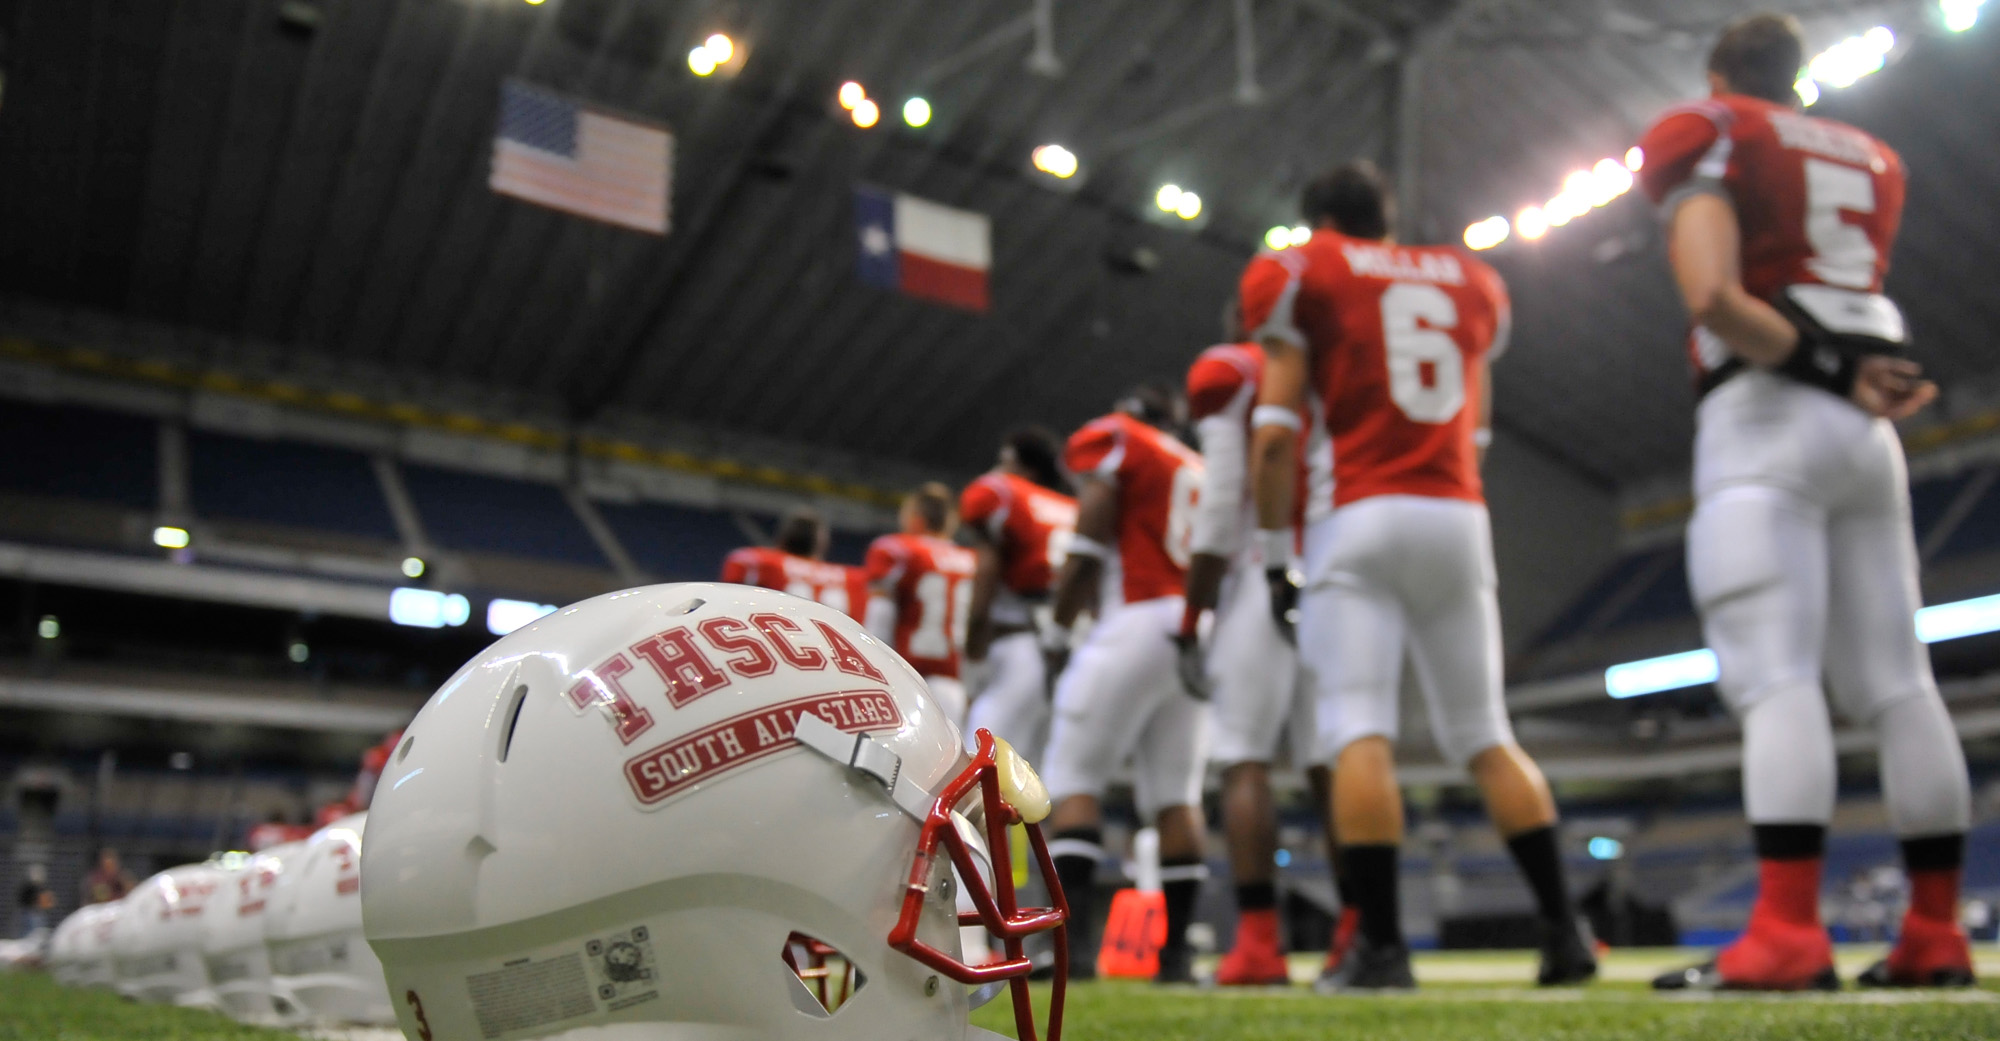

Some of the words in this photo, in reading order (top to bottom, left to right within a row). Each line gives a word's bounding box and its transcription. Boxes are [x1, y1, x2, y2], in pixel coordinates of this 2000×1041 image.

[1804, 158, 1878, 289] 5
[1380, 282, 1466, 424] 6
[568, 612, 889, 746] THSCA
[641, 727, 744, 790] SOUTH
[817, 697, 893, 727] STARS
[406, 989, 433, 1041] 3
